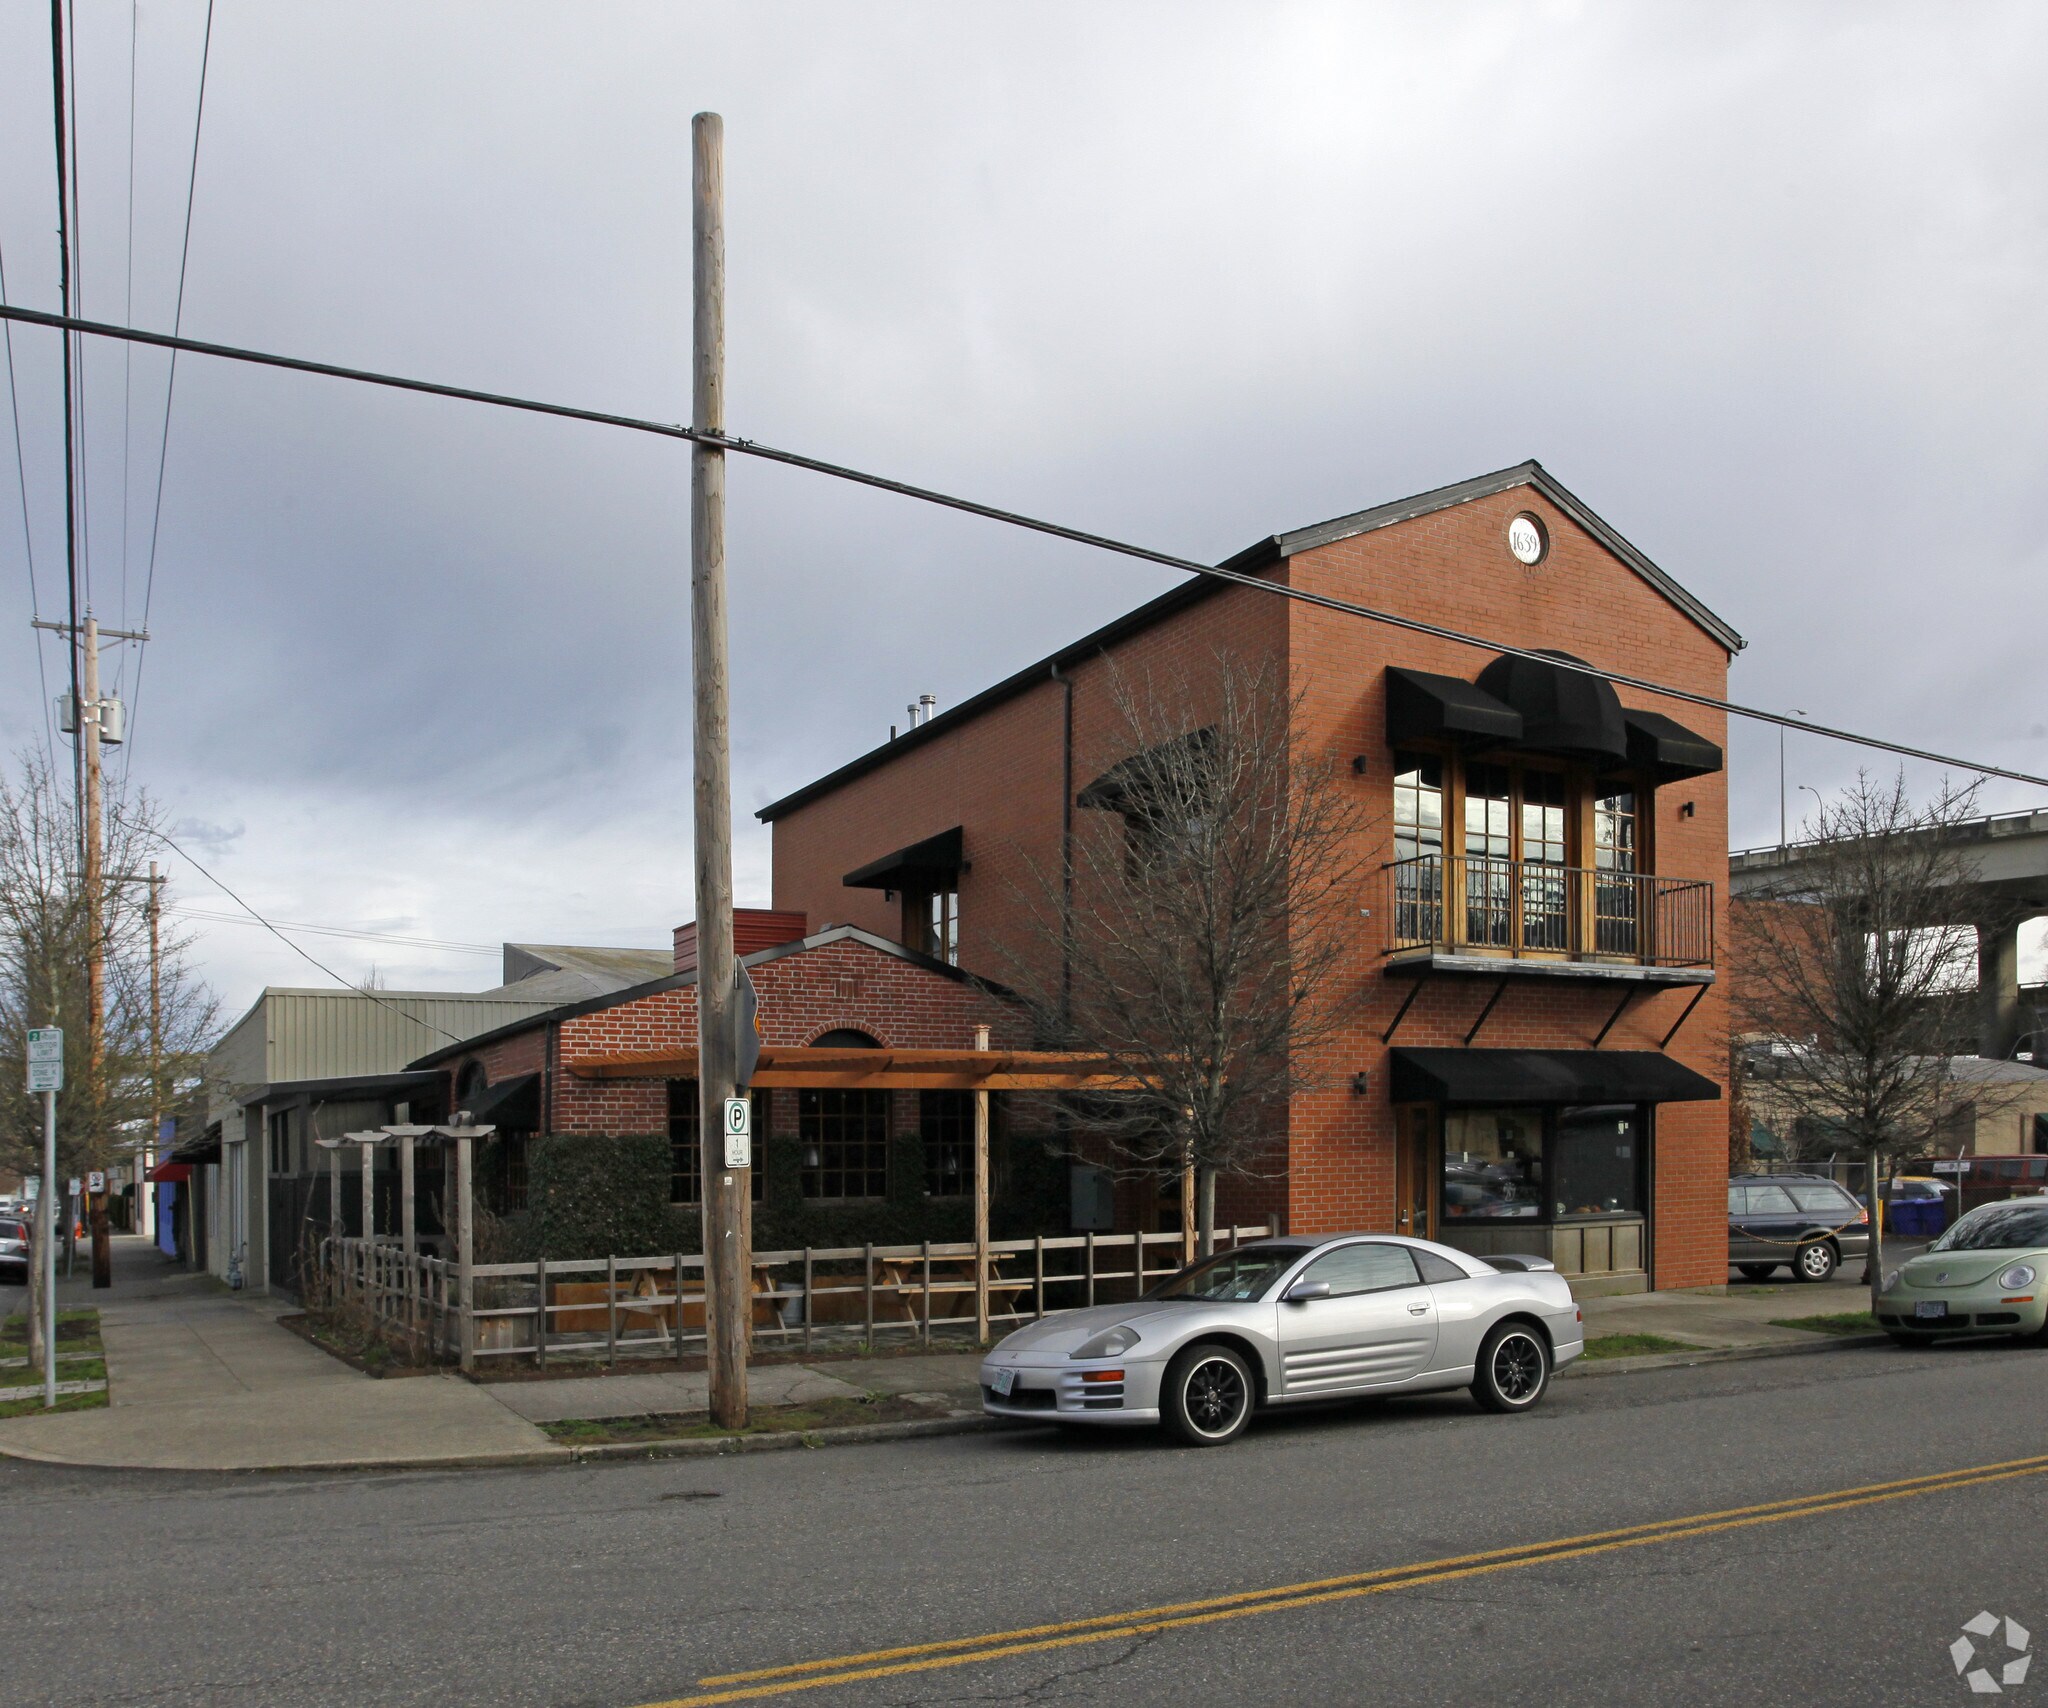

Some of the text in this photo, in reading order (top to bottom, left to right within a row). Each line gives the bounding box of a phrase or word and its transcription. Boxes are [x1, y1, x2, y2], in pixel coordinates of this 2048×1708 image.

[1513, 532, 1537, 553] 1639
[33, 1032, 38, 1041] 2
[32, 1069, 48, 1077] ZONE
[733, 1108, 742, 1127] P
[735, 1138, 739, 1148] 1
